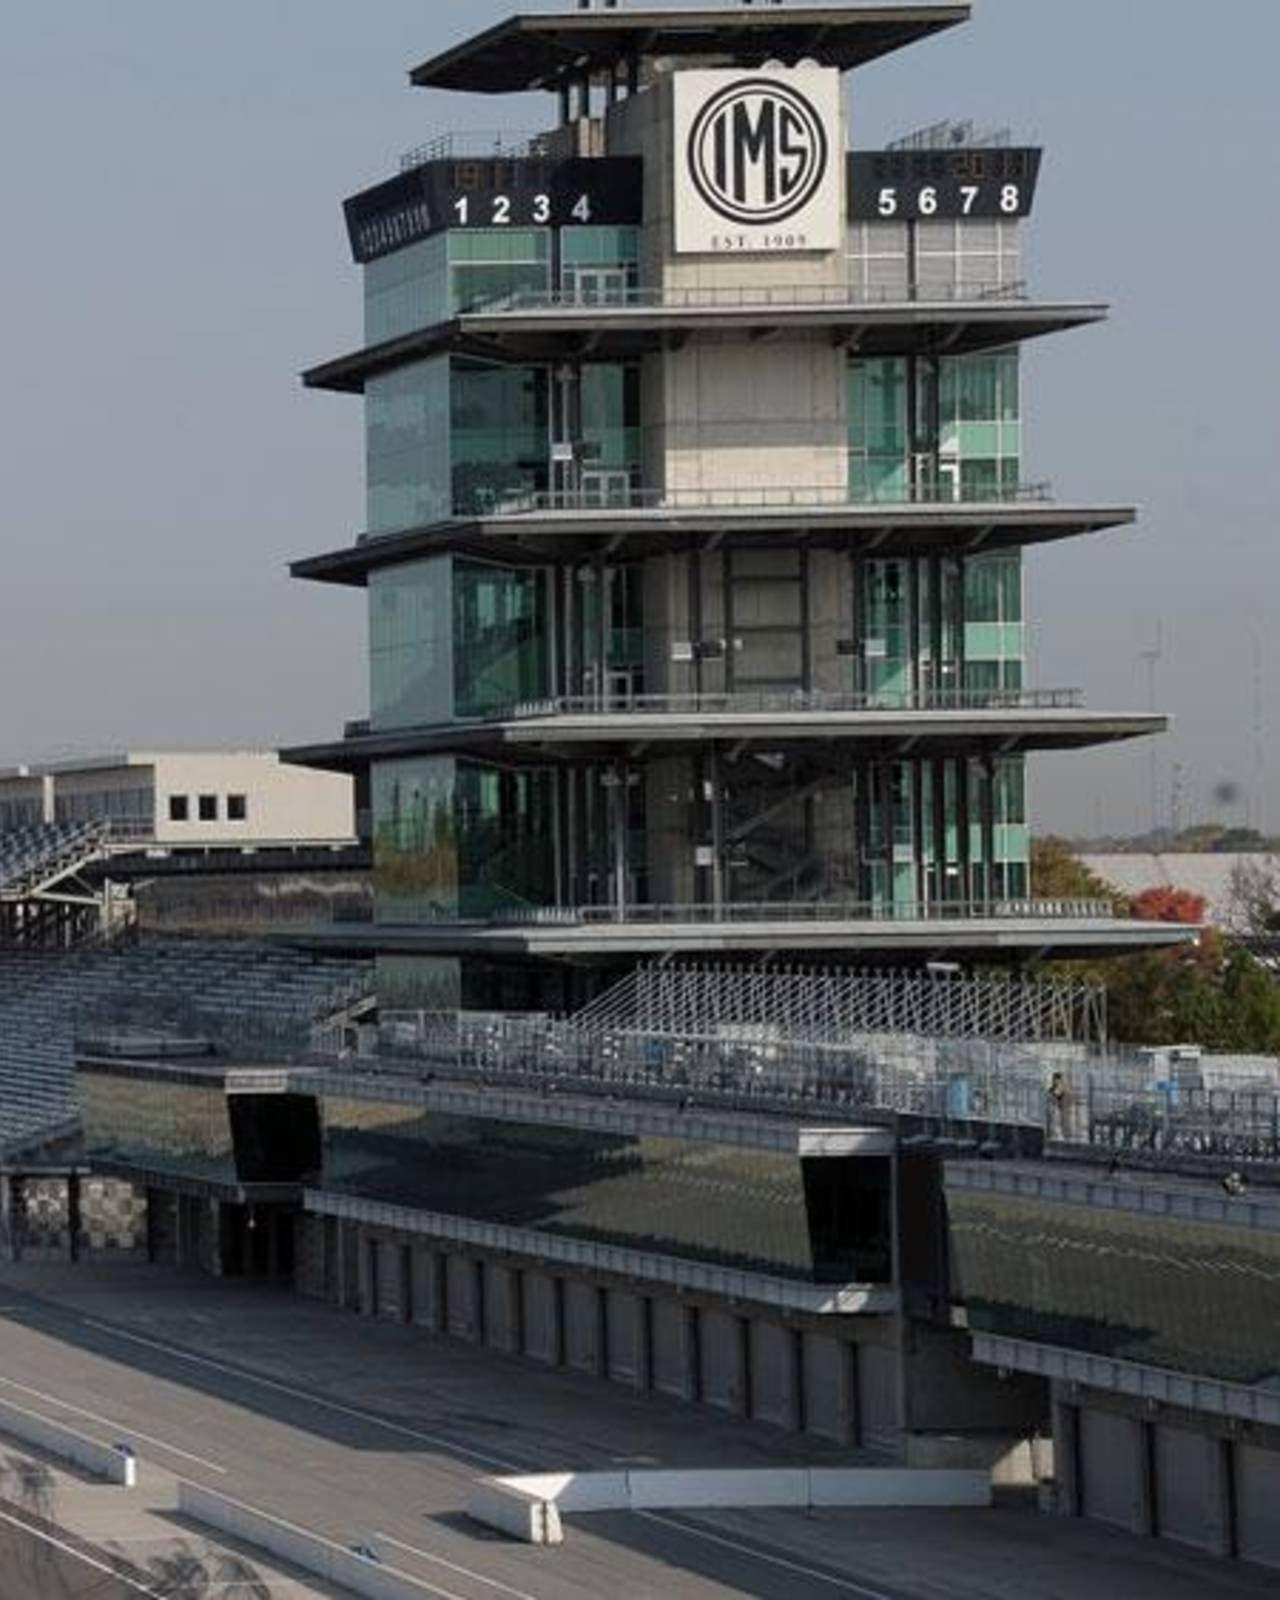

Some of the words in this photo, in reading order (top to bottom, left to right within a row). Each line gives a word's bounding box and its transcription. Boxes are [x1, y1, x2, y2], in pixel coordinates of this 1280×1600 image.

[711, 98, 810, 204] IMS
[454, 195, 468, 224] 1
[492, 195, 510, 223] 2
[533, 194, 550, 223] 3
[572, 194, 591, 222] 4
[878, 188, 897, 216] 5
[918, 186, 937, 215] 6
[960, 186, 979, 214] 7
[1000, 184, 1019, 212] 8
